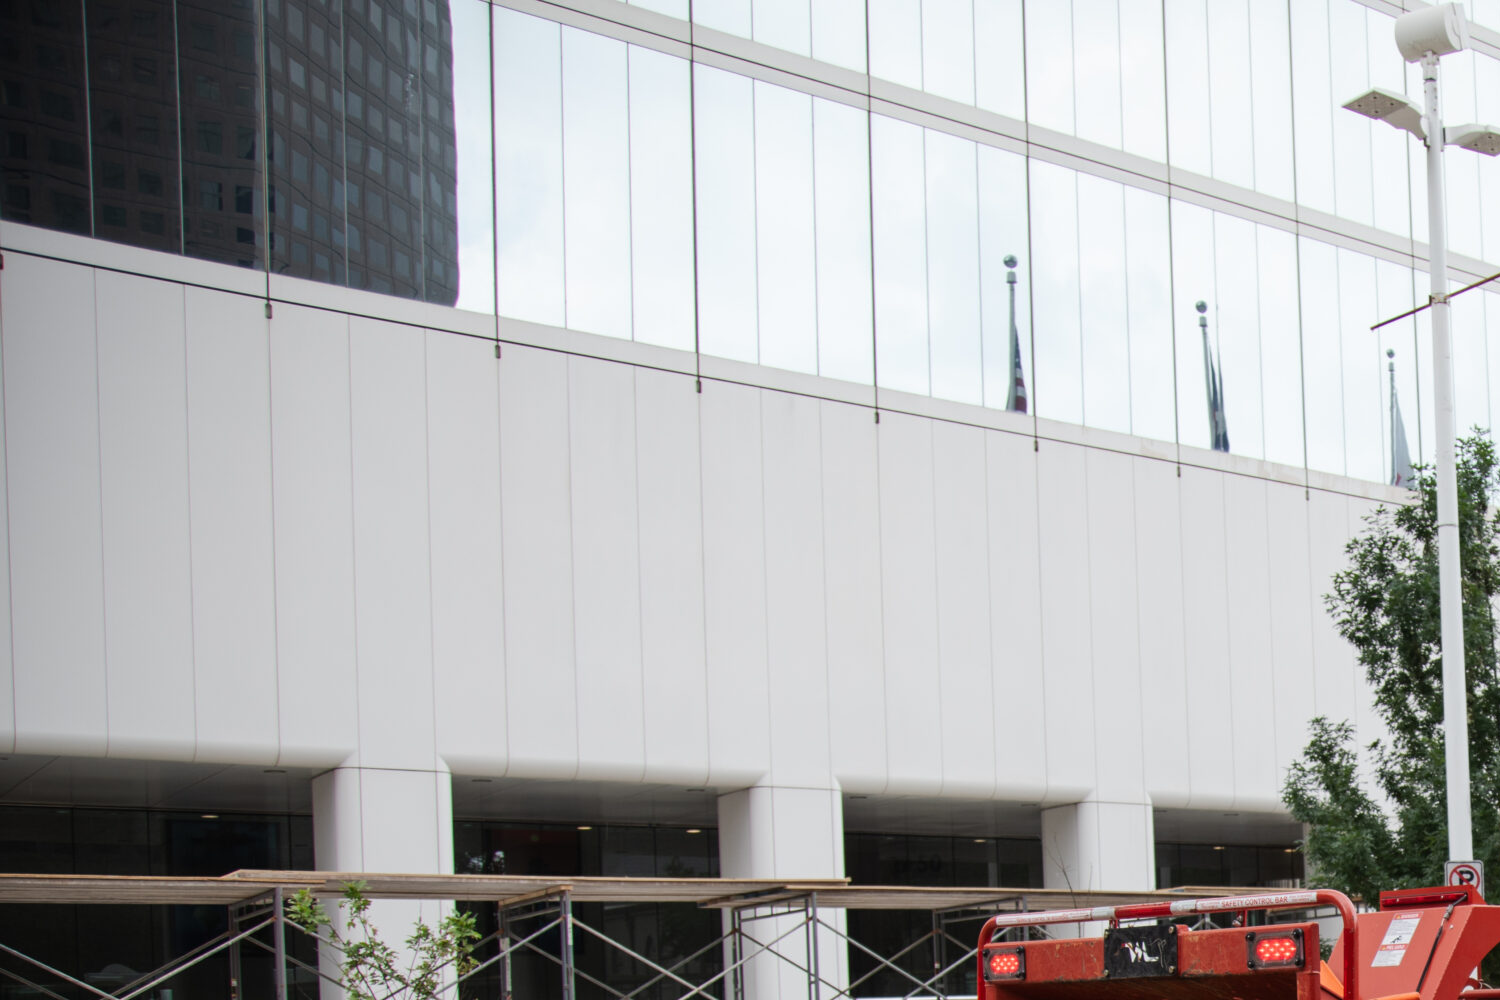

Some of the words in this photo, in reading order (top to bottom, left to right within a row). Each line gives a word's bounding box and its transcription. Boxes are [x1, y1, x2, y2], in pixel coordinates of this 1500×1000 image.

[1221, 899, 1243, 908] SAFETY
[1244, 897, 1273, 906] CONTROL
[1274, 896, 1288, 904] BAR
